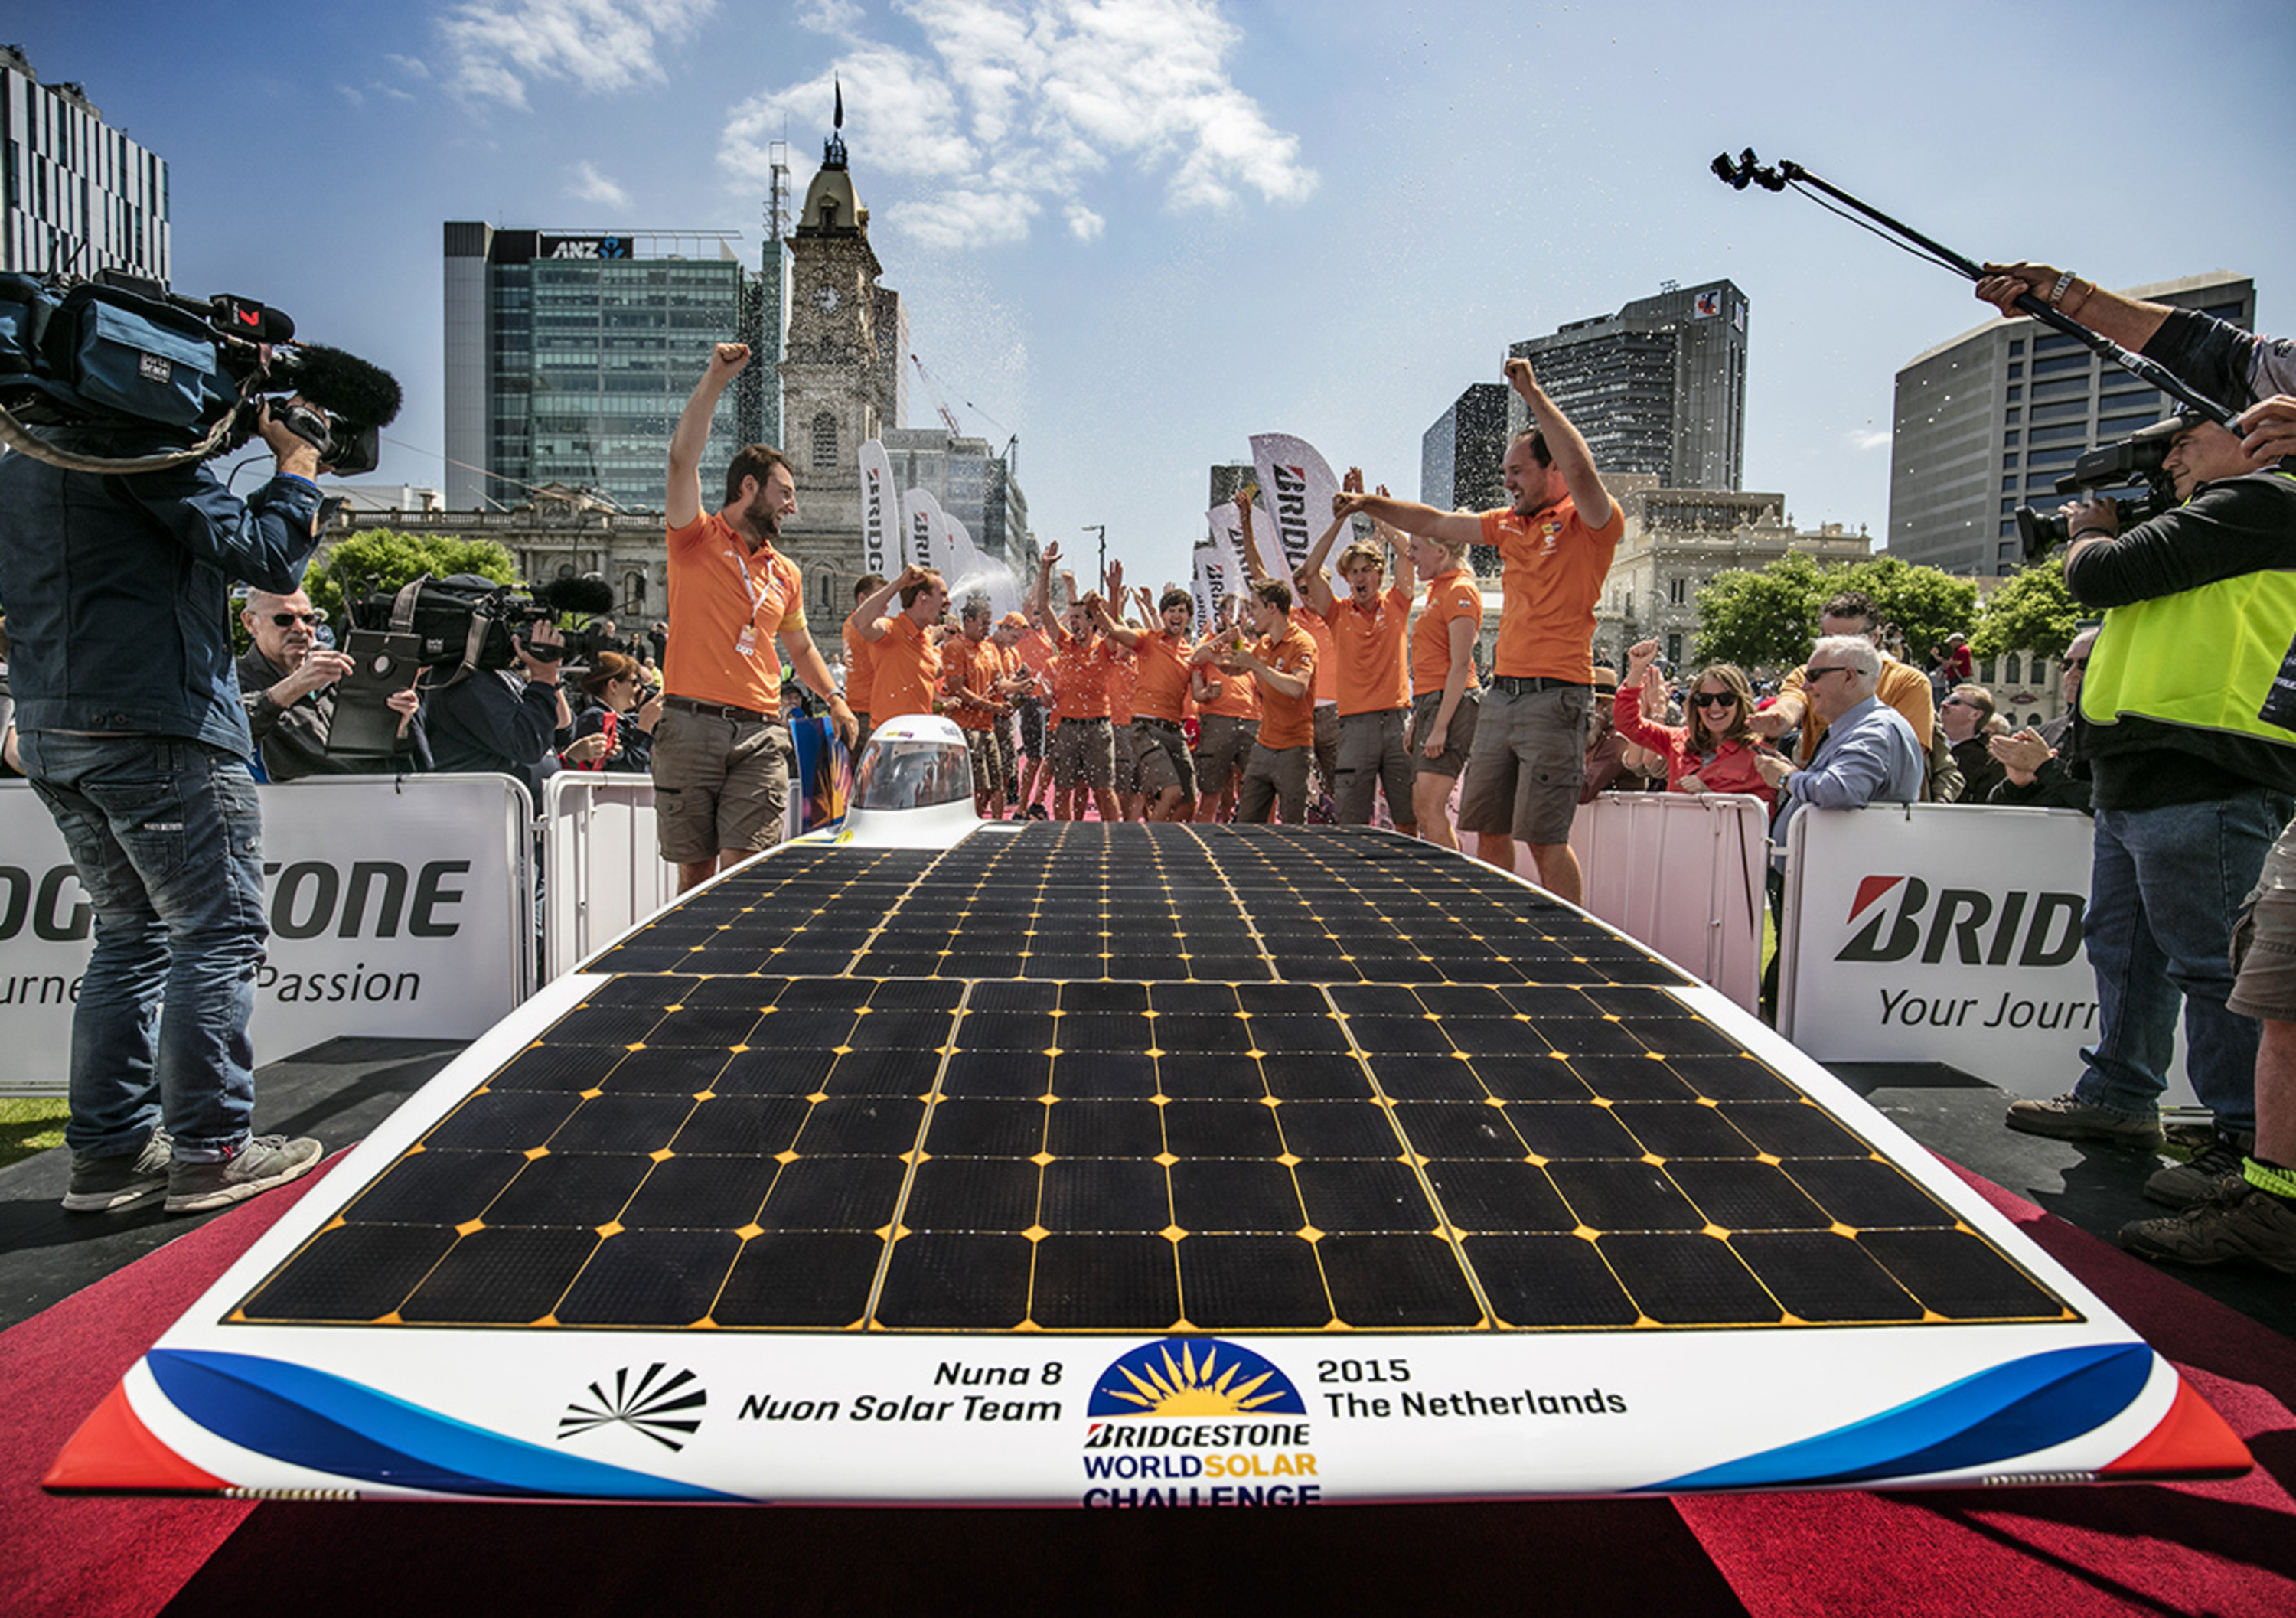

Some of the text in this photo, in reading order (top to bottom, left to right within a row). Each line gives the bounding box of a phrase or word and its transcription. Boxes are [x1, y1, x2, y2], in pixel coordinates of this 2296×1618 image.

[551, 240, 598, 259] ANZ
[239, 309, 259, 327] 7
[1834, 875, 2087, 967] BRID
[257, 962, 420, 1002] Passion
[1880, 989, 1978, 1026] Your
[934, 1362, 1063, 1385] Nuna 8
[1317, 1359, 1411, 1382] 2015
[737, 1395, 1062, 1421] Nuon Solar Team
[1323, 1388, 1627, 1417] The Netherlands
[1084, 1423, 1310, 1448] BRIDGESTONE
[1083, 1485, 1321, 1509] CHALLENGE
